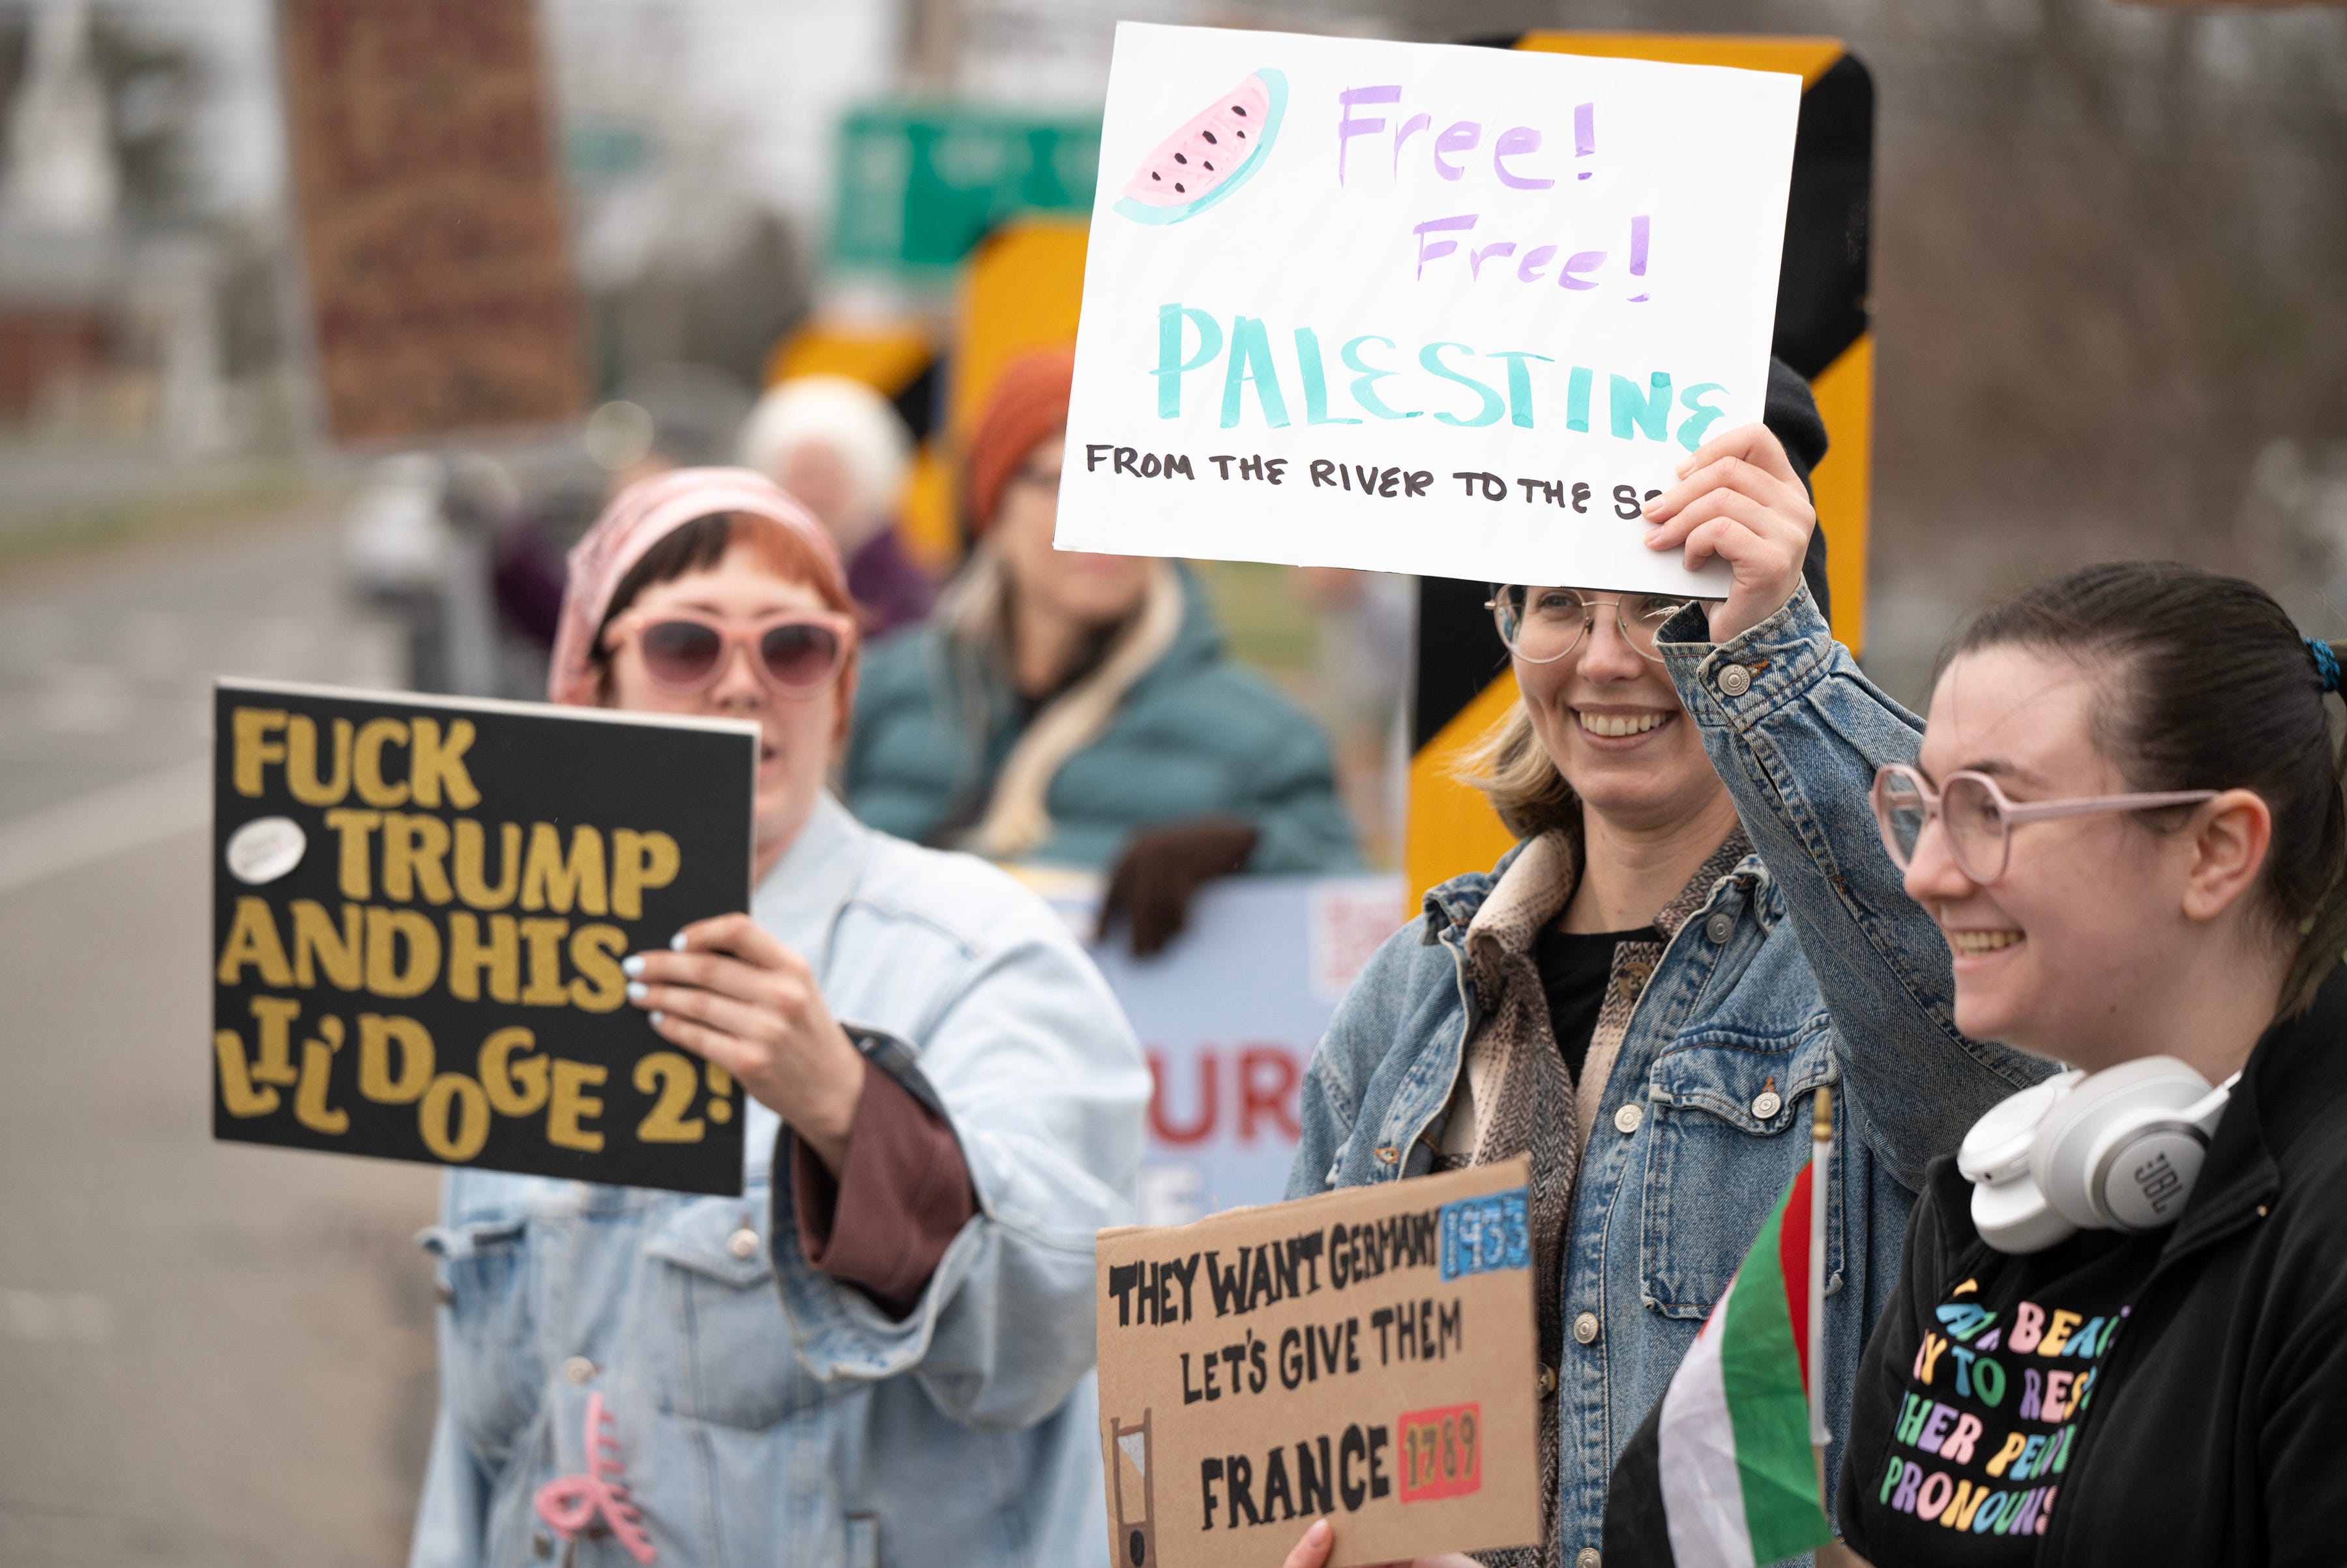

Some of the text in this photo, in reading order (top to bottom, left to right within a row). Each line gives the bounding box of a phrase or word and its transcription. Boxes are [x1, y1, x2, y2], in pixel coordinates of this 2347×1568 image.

[1338, 85, 1595, 189] Free!
[1413, 214, 1650, 303] Free!
[1149, 303, 1732, 454] PALESTINE
[1086, 444, 1663, 520] FROM THE RIVER TO THE S
[232, 706, 482, 810] FUCK
[325, 808, 681, 921] TRUMP
[2134, 1151, 2183, 1214] JBL
[1109, 1252, 1201, 1327] THEY
[1205, 1231, 1323, 1318] WANT
[1330, 1207, 1441, 1290] GERMANY
[1180, 1297, 1462, 1405] LET'S GIVE THEM
[1951, 1344, 2007, 1408] TO
[1201, 1410, 1476, 1531] FRANCE 1789
[1895, 1390, 1983, 1466] HER
